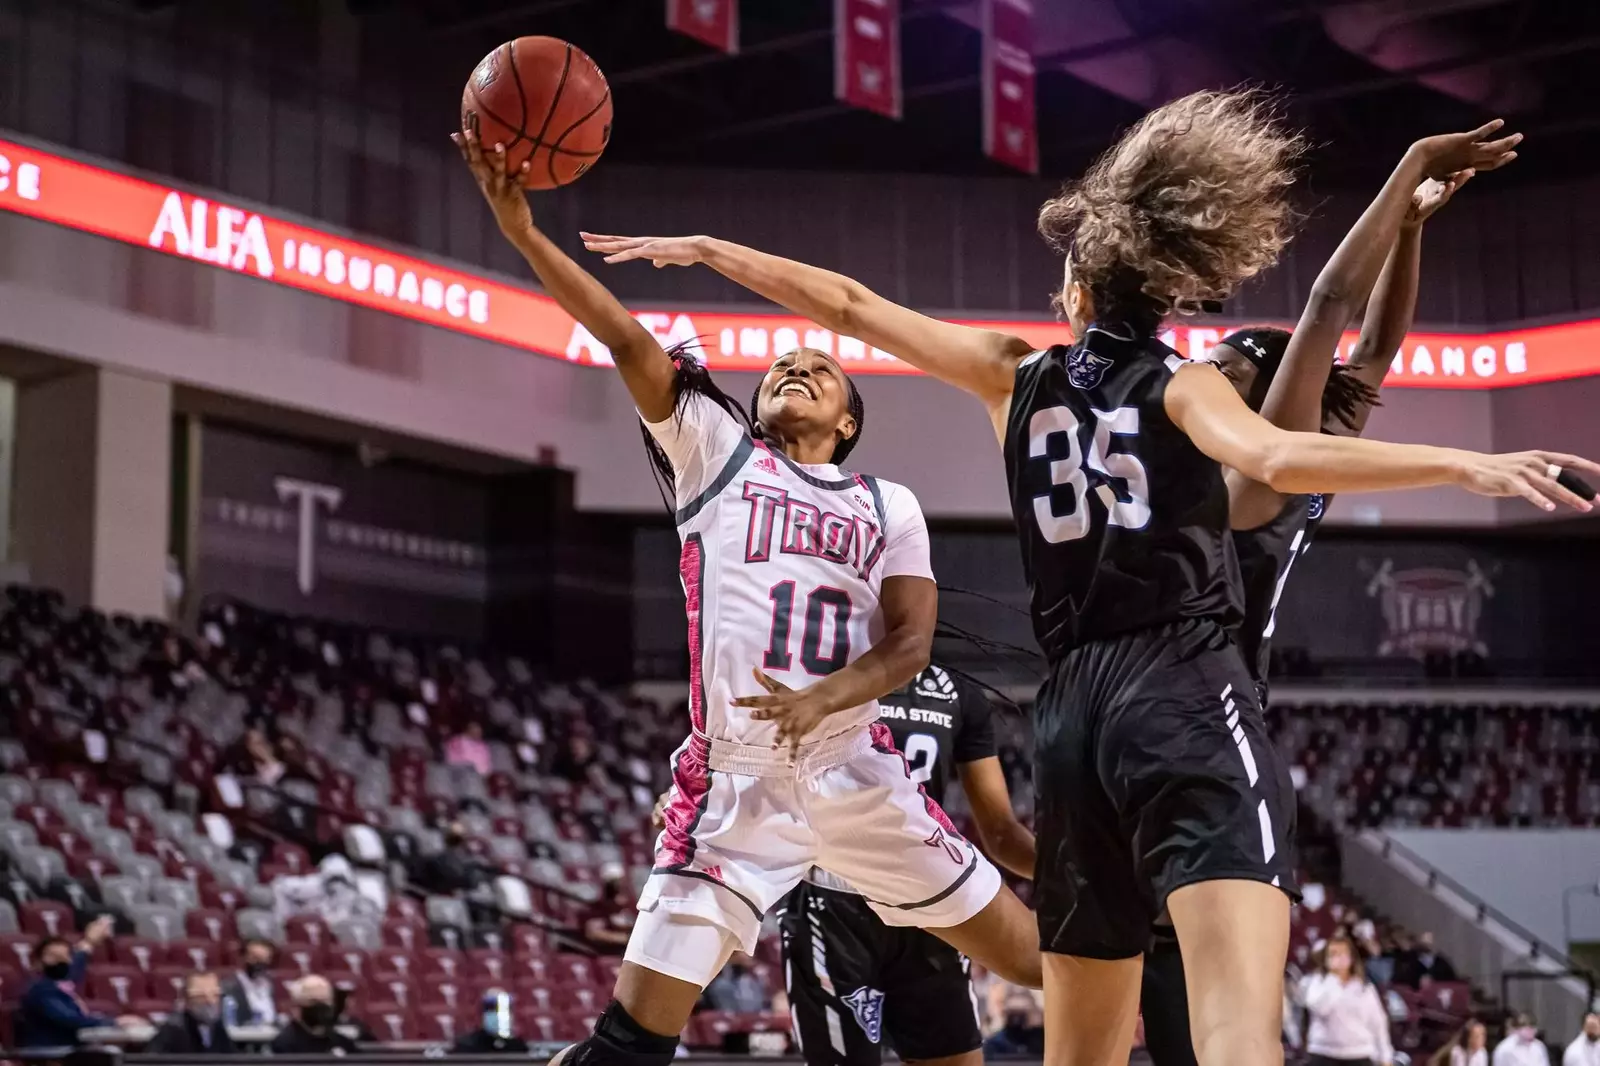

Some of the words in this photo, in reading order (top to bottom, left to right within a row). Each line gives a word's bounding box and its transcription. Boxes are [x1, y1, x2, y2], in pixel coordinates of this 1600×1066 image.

[149, 191, 274, 278] ALFA
[283, 239, 489, 324] INSURANCE
[565, 313, 708, 368] AFA
[1028, 405, 1152, 544] 35
[273, 475, 342, 596] T
[742, 480, 886, 582] TROY
[763, 580, 853, 677] 10
[909, 708, 953, 729] STATE
